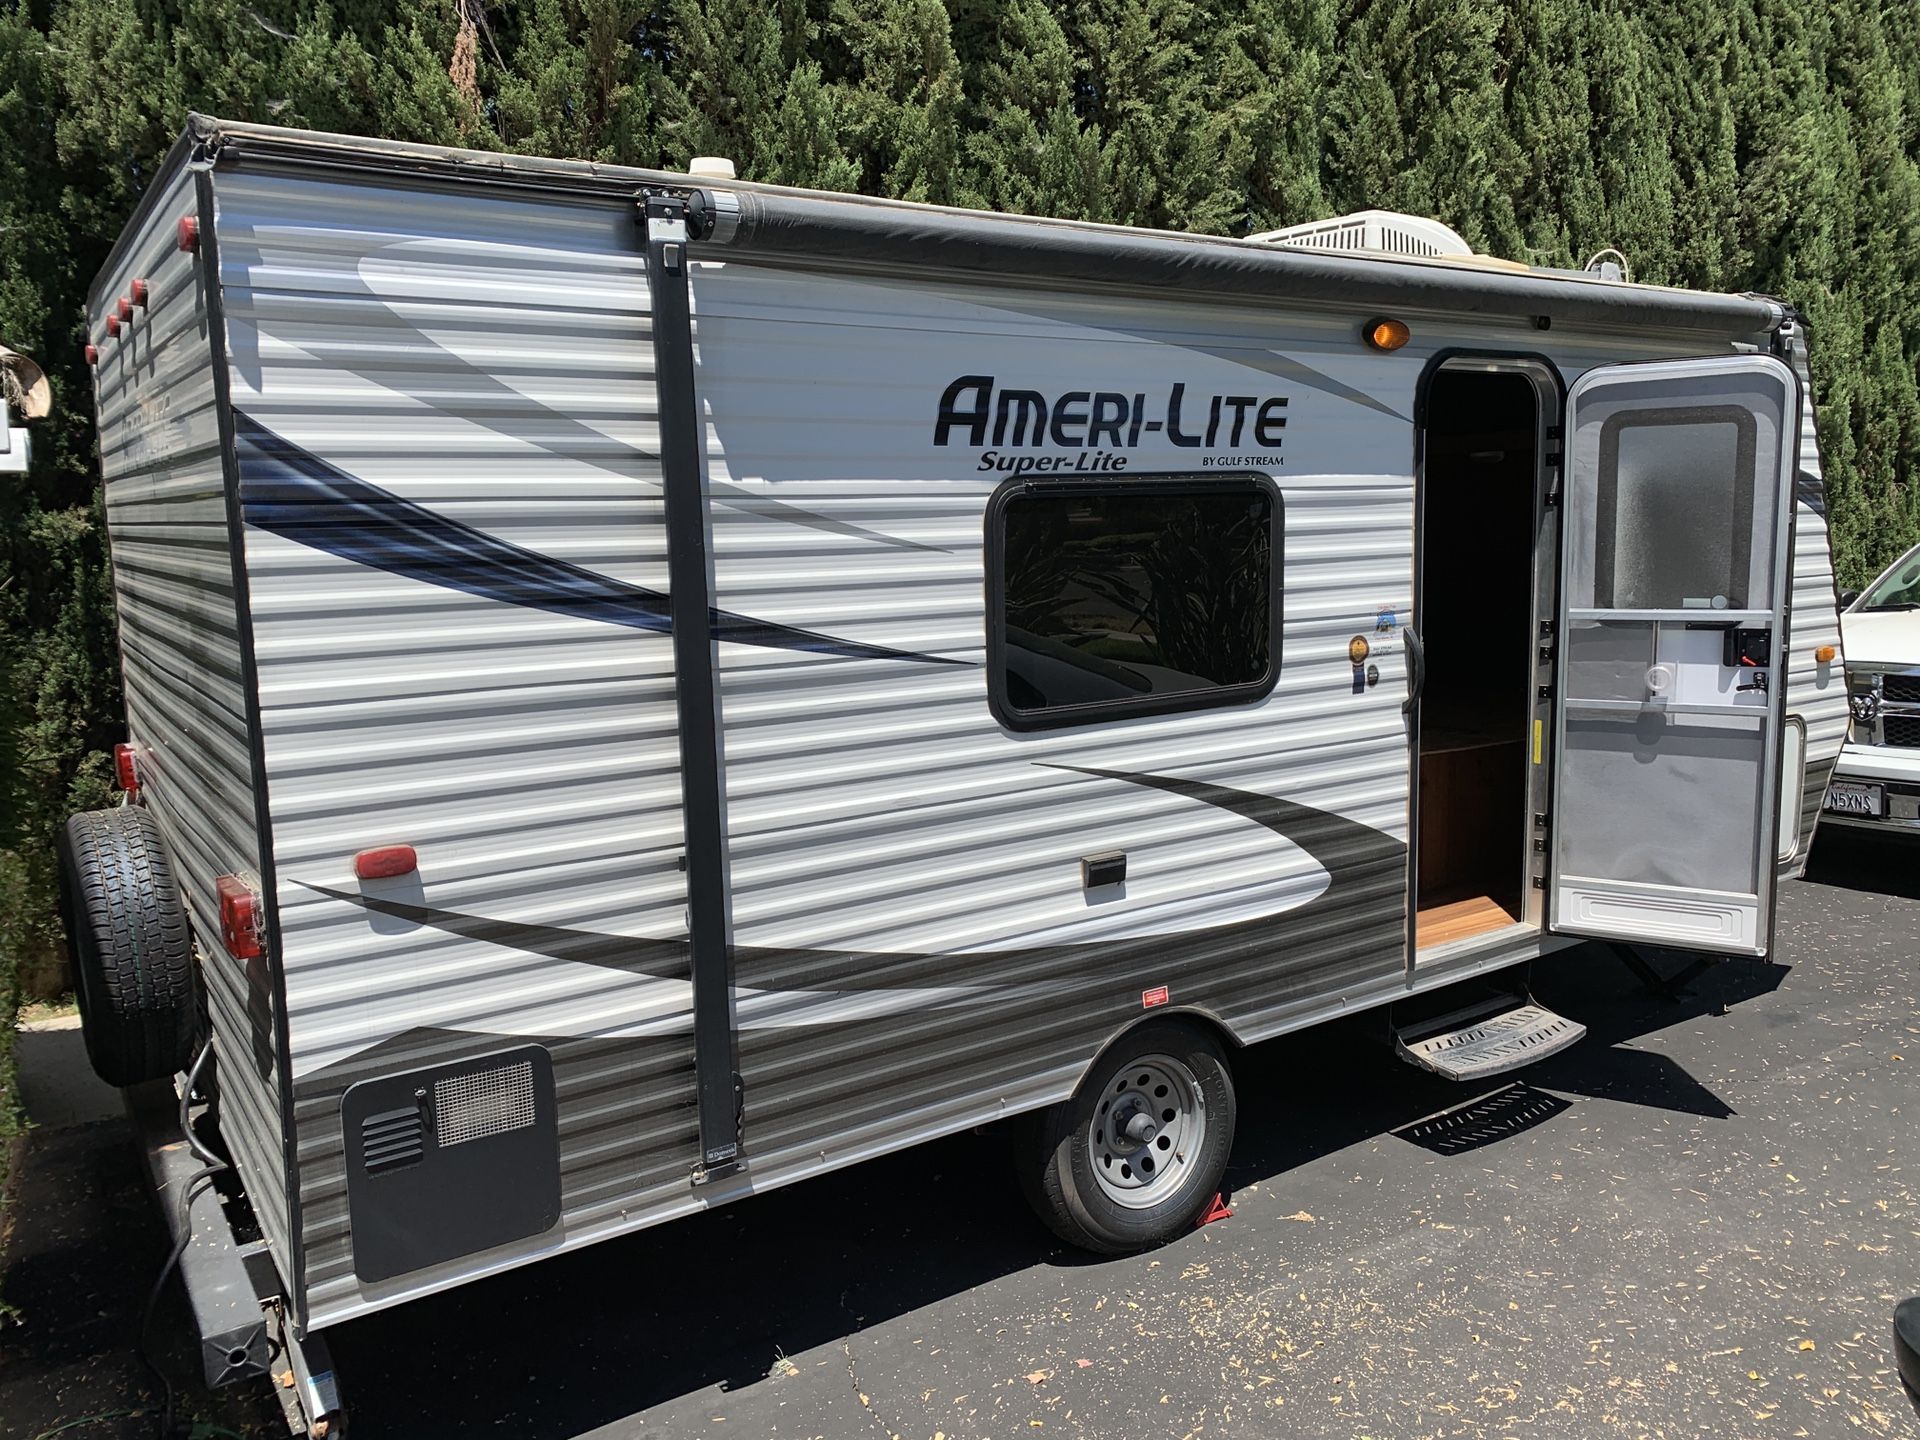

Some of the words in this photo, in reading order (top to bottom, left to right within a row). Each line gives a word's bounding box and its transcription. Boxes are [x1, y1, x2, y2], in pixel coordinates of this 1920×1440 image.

[977, 450, 1127, 476] Super-Lite
[1202, 456, 1216, 466] BY
[1217, 456, 1242, 466] GULF
[1244, 456, 1284, 466] STREAM
[1831, 792, 1871, 811] N5XNS
